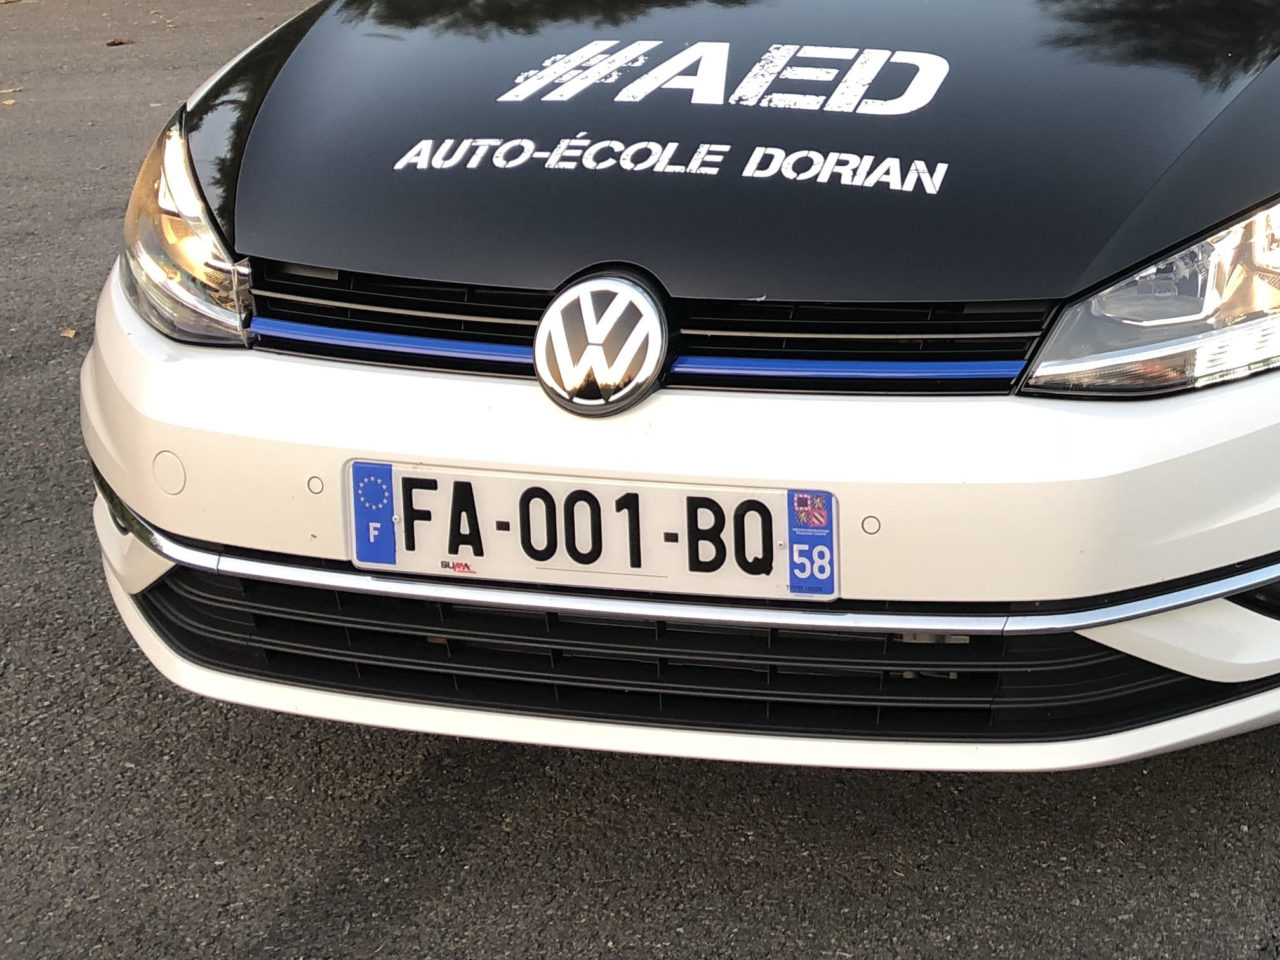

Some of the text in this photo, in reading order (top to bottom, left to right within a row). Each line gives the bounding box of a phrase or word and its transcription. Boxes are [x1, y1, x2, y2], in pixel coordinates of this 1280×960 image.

[393, 132, 948, 195] AUTO-ÉCOLE DORIAN
[368, 522, 382, 543] F
[401, 476, 775, 577] FA-001-BQ
[792, 543, 831, 580] 58
